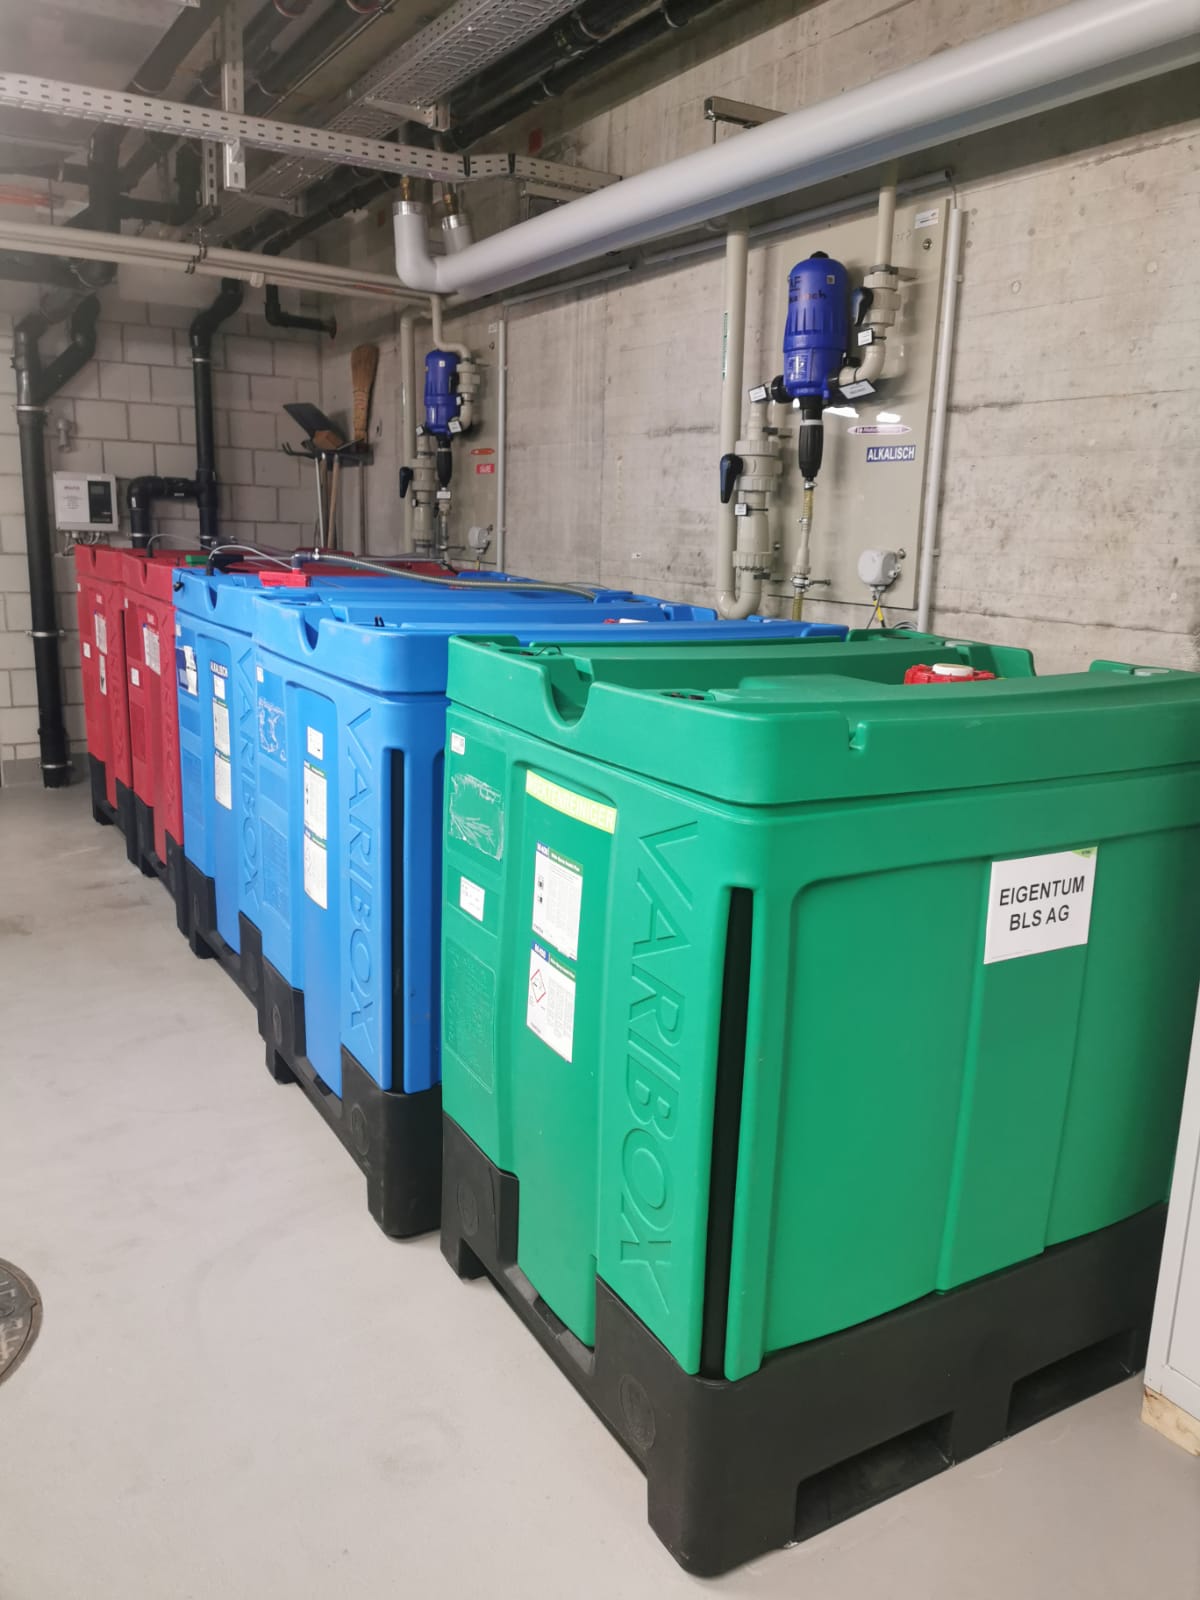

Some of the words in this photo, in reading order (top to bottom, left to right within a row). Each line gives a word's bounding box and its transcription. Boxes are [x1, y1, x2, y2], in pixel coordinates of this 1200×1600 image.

[867, 446, 915, 461] ALKALISCH
[347, 707, 373, 1054] VARIBOX
[999, 875, 1085, 907] EIGENTUM
[1009, 909, 1042, 931] BLS
[1045, 904, 1070, 925] AG
[620, 820, 698, 1315] VARIBOX
